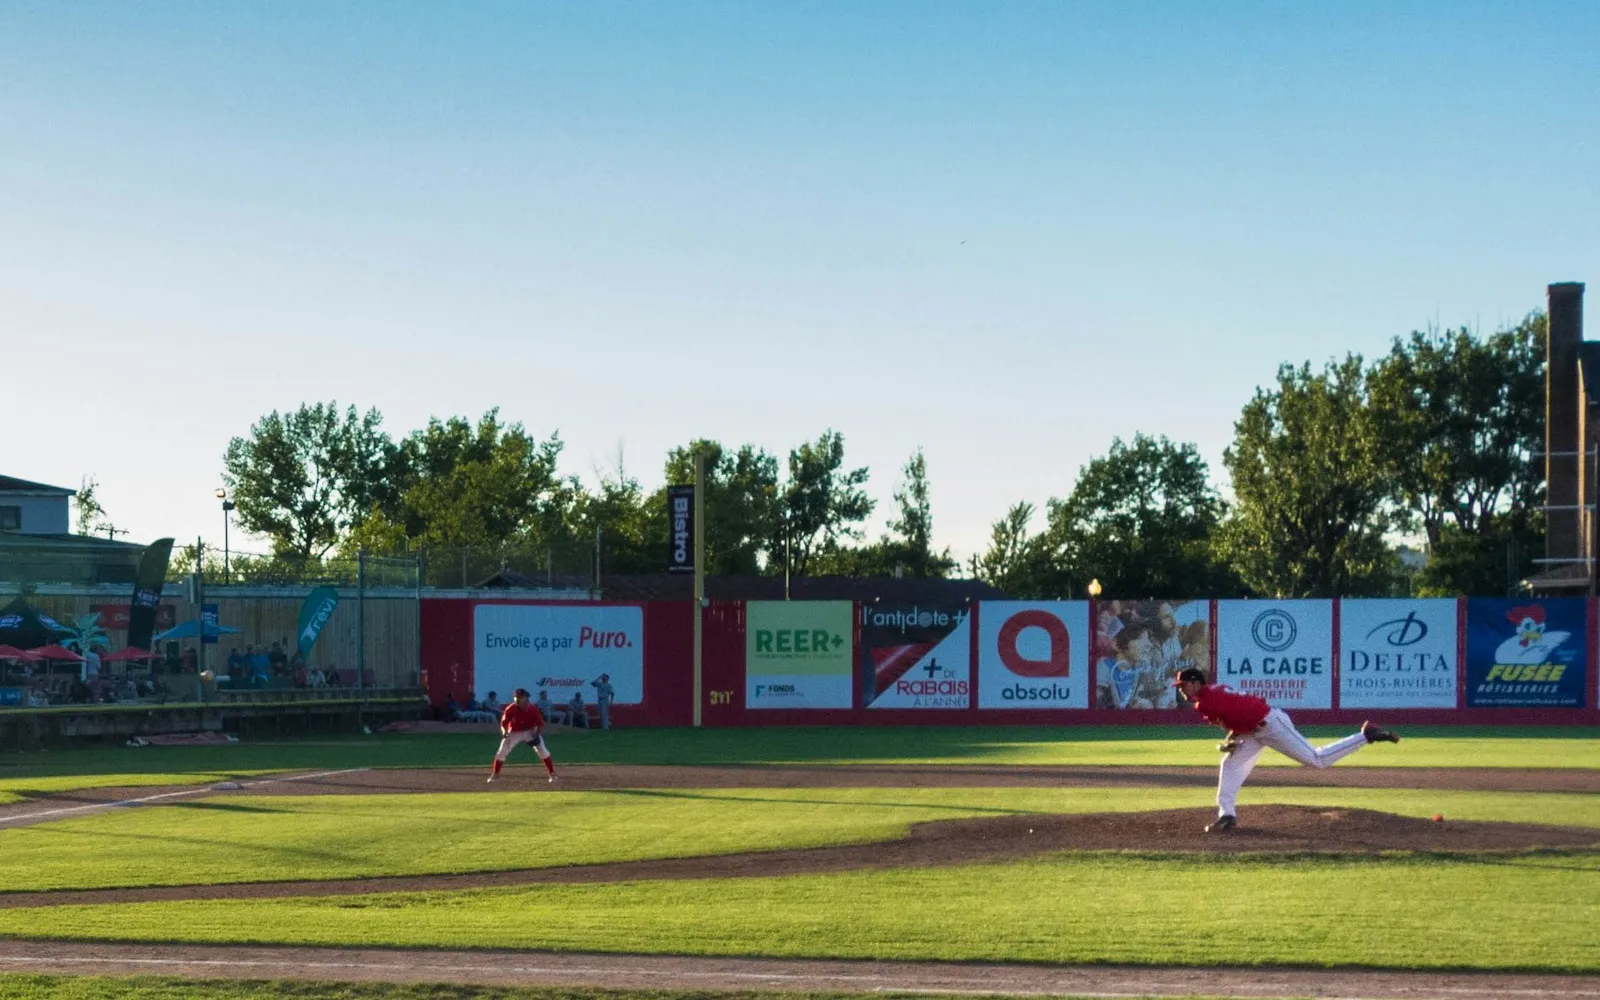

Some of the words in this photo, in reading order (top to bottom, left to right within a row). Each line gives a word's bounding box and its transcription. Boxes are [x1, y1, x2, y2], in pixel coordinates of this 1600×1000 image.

[675, 498, 689, 563] Bistro
[486, 633, 530, 648] Envoie
[534, 637, 548, 652] ça
[552, 637, 573, 652] par
[578, 626, 632, 649] Puro.
[756, 630, 844, 652] REER+
[1227, 657, 1252, 674] LA
[1263, 657, 1323, 674] CAGE
[1349, 650, 1450, 672] DELTA
[1486, 662, 1567, 681] FUSÉE
[768, 684, 795, 693] FONDS
[1002, 683, 1070, 700] absolu
[1240, 679, 1307, 689] BRASSERIE
